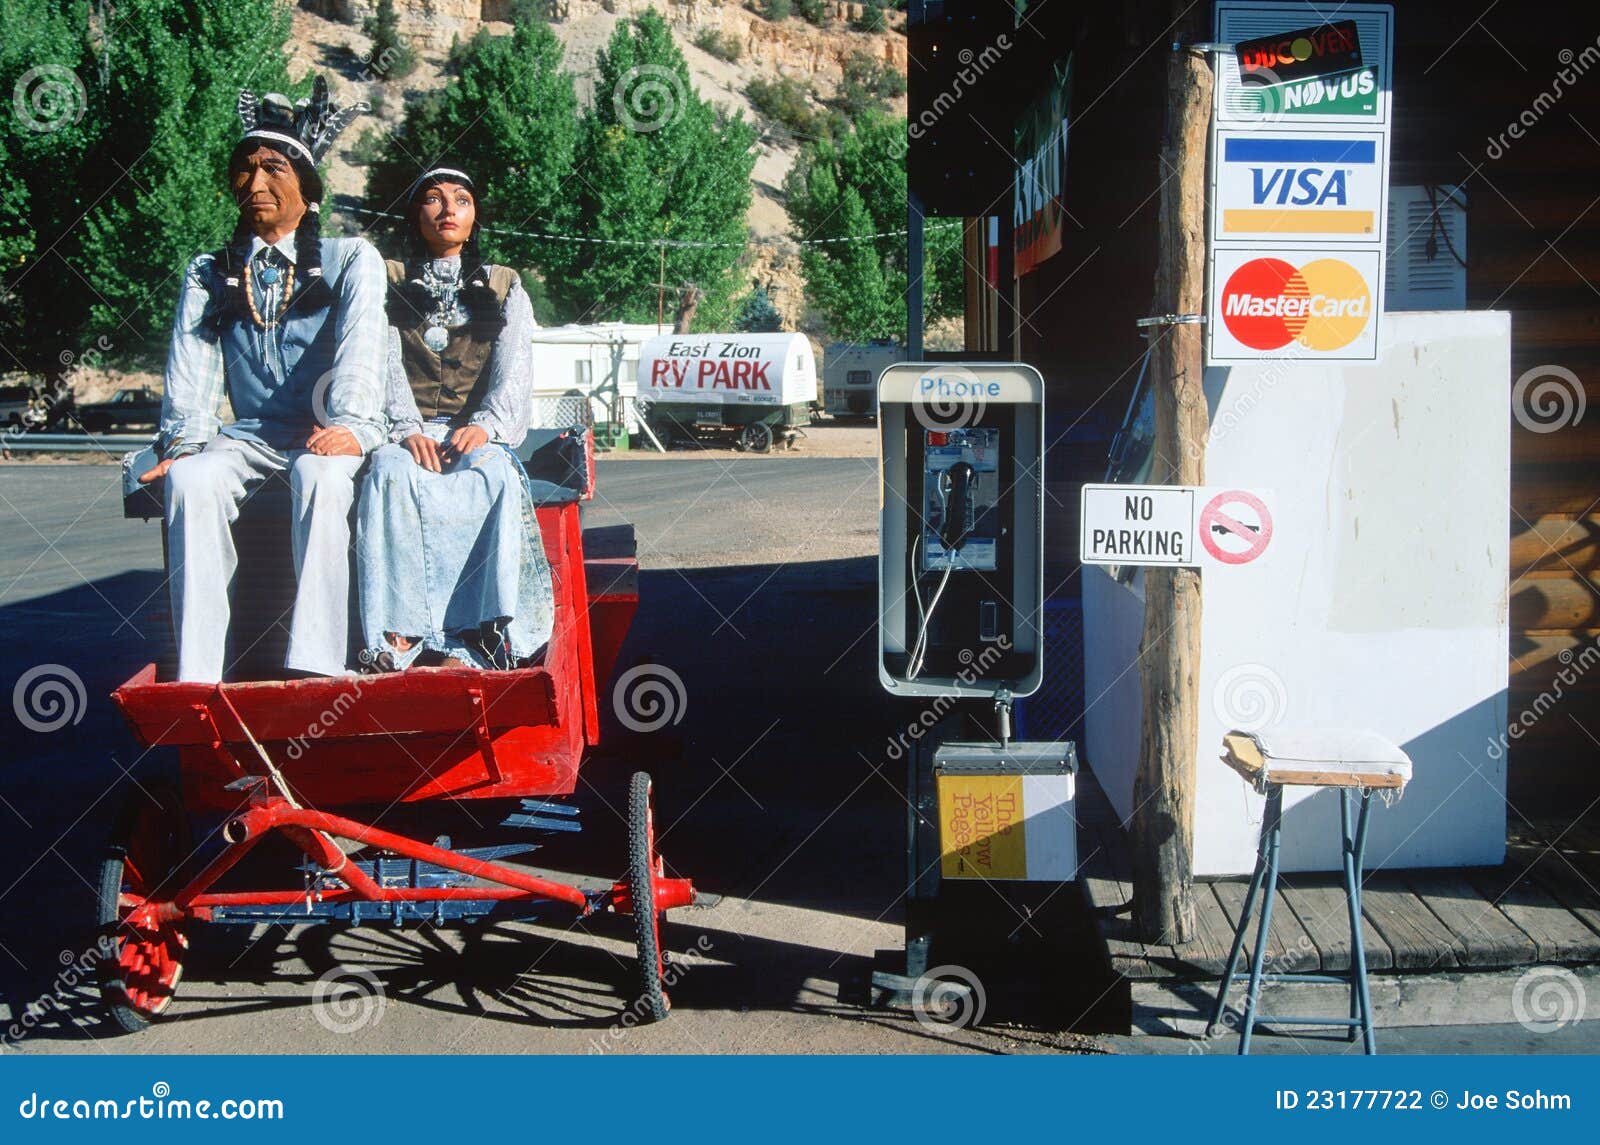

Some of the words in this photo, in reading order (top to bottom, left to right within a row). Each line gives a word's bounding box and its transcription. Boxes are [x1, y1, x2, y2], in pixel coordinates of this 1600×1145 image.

[1248, 168, 1347, 206] VISA
[1226, 294, 1367, 318] MasterCard
[669, 342, 711, 358] East
[719, 342, 761, 358] Zion
[652, 360, 689, 388] RV
[697, 360, 771, 390] PARK
[919, 378, 1000, 397] Phone
[1125, 495, 1153, 521] NO
[1093, 529, 1183, 556] PARKING
[949, 793, 972, 856] Pages
[995, 792, 1016, 836] The
[973, 792, 994, 869] Yellow
